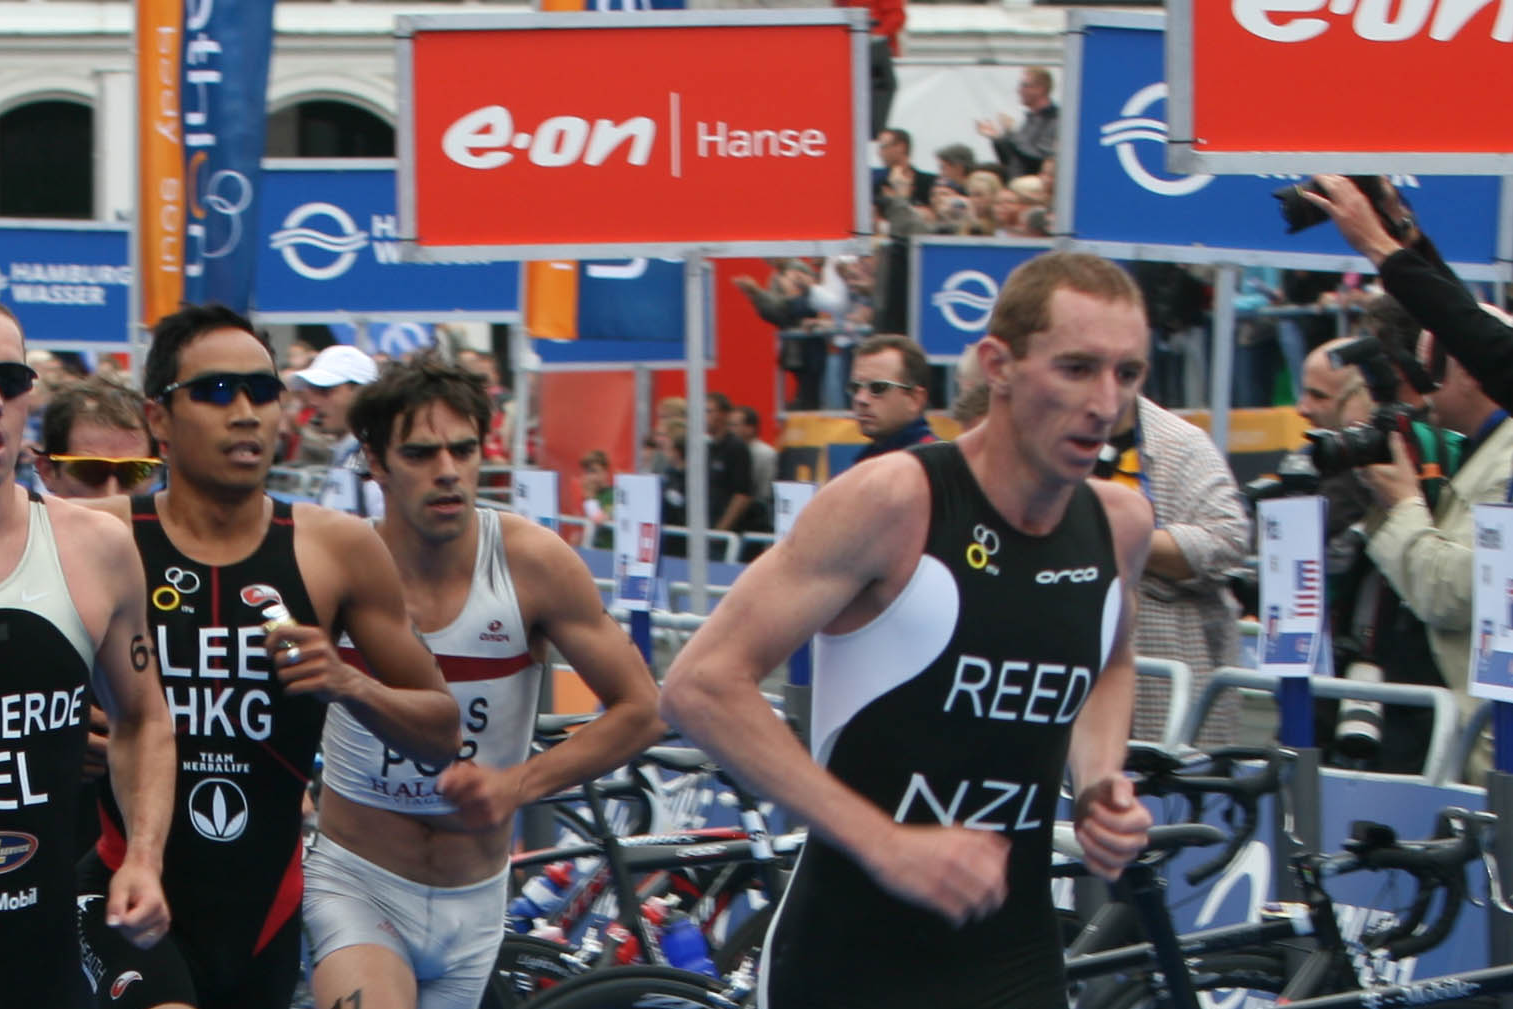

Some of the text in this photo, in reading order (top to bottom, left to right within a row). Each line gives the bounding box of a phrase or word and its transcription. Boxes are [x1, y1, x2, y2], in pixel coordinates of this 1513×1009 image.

[697, 121, 828, 158] Hanse
[9, 262, 133, 286] HAMBURG
[11, 284, 106, 305] WASSER
[1035, 567, 1098, 584] orca
[157, 624, 270, 681] LEE
[943, 655, 1092, 725] REED
[166, 686, 272, 741] HKG
[893, 773, 1041, 830] NZL
